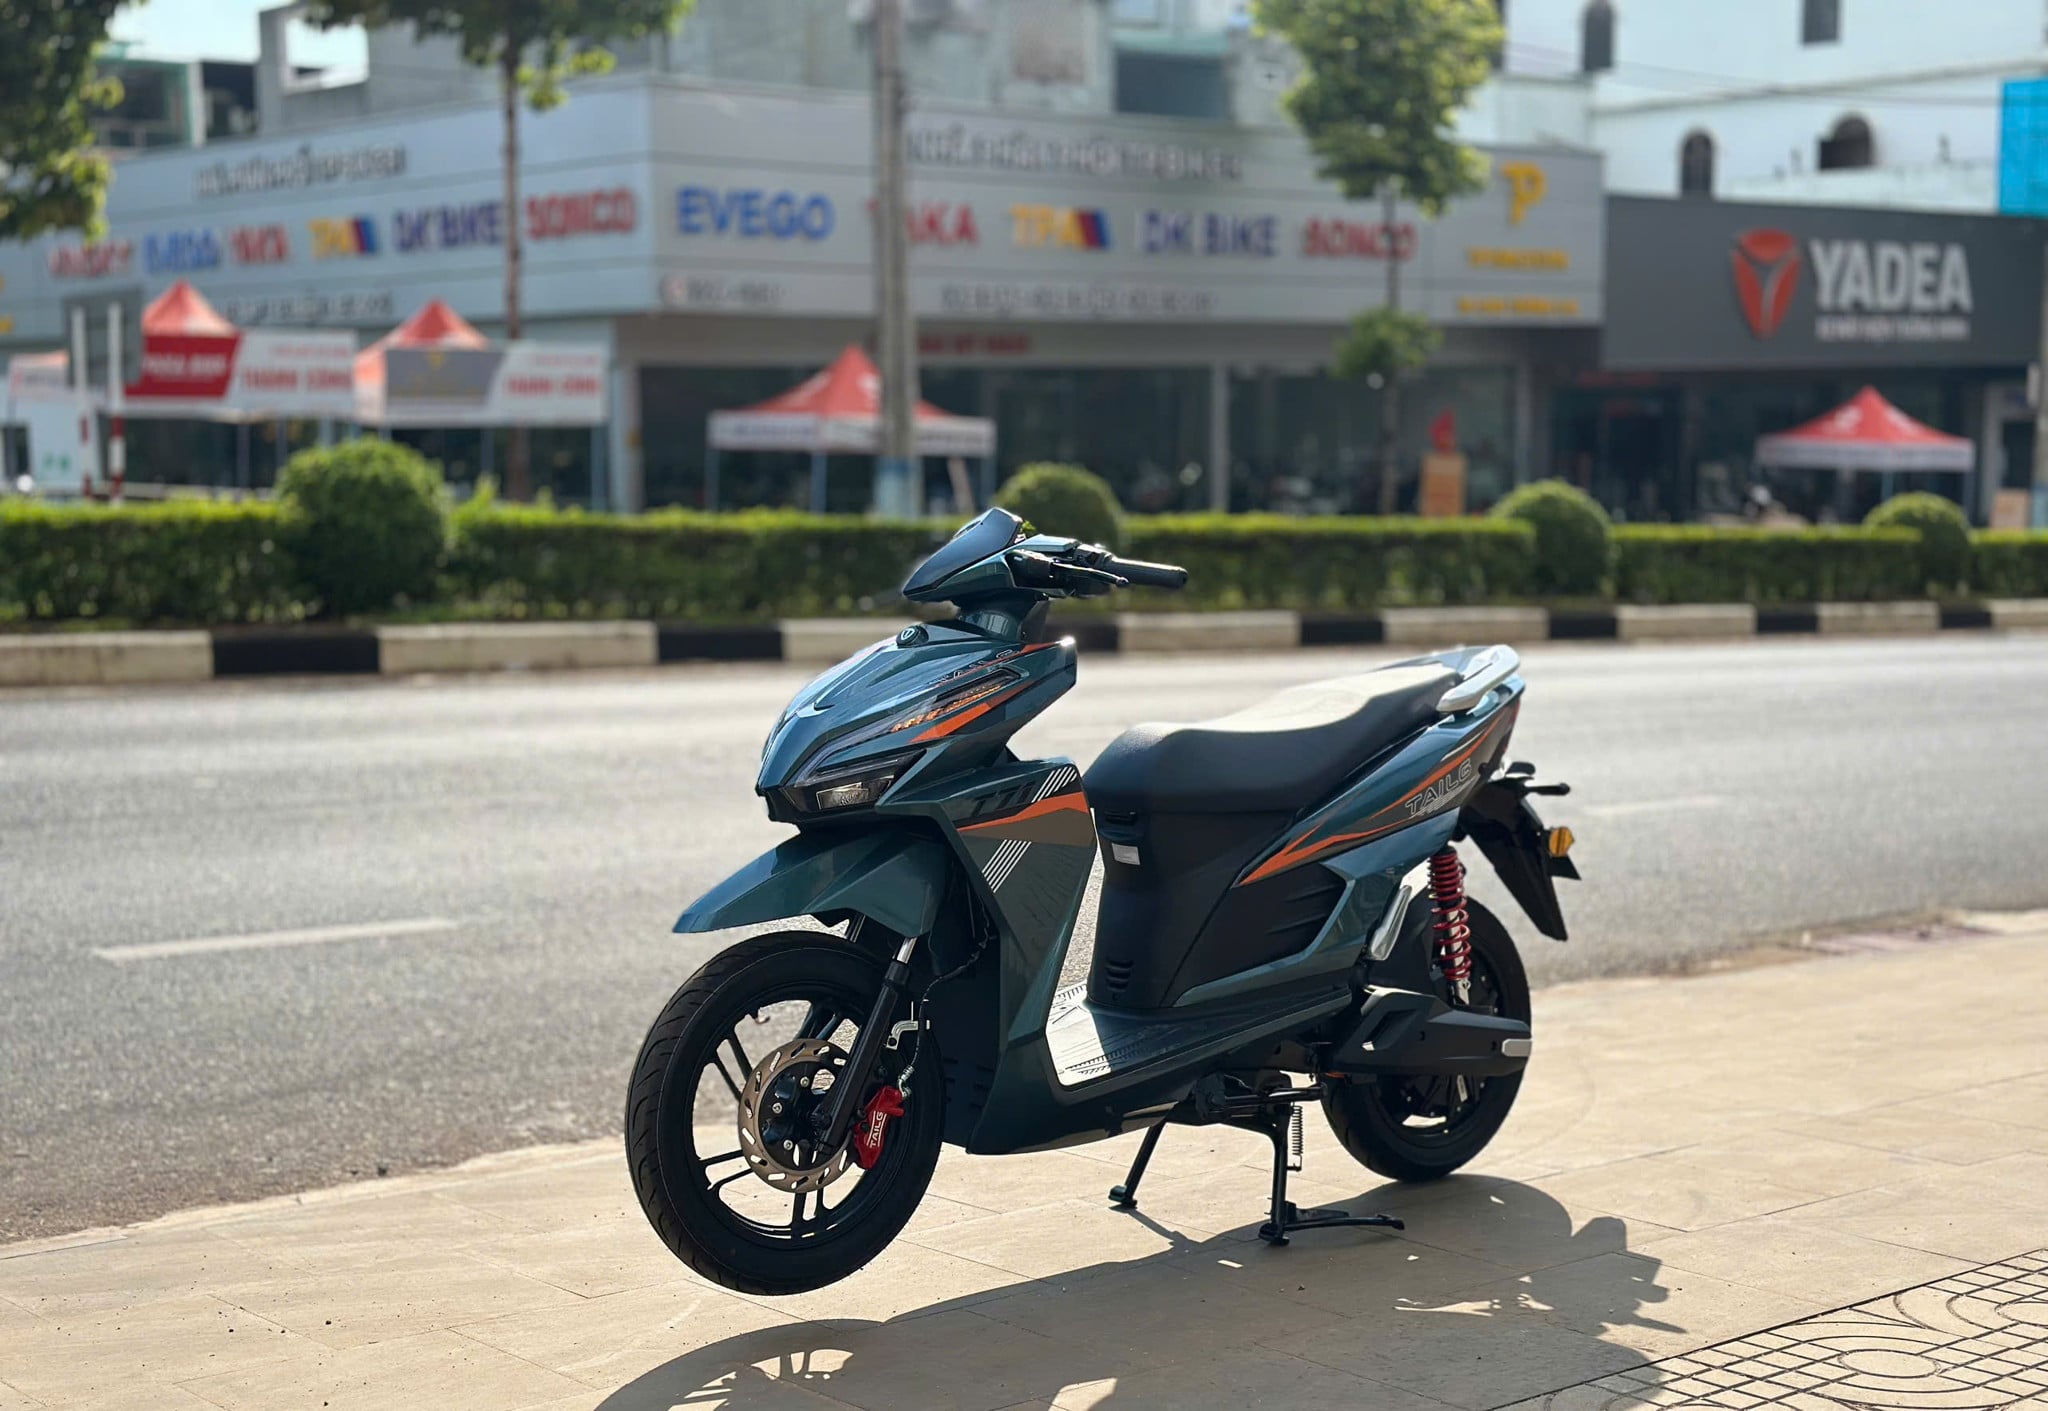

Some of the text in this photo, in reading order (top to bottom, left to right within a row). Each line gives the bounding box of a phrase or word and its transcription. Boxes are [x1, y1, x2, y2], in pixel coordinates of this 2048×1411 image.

[675, 186, 838, 240] EVEGO
[1205, 211, 1279, 256] BIKE
[1808, 239, 1972, 312] YADEA
[1405, 758, 1472, 815] TAILG
[869, 1111, 884, 1149] TAILG
